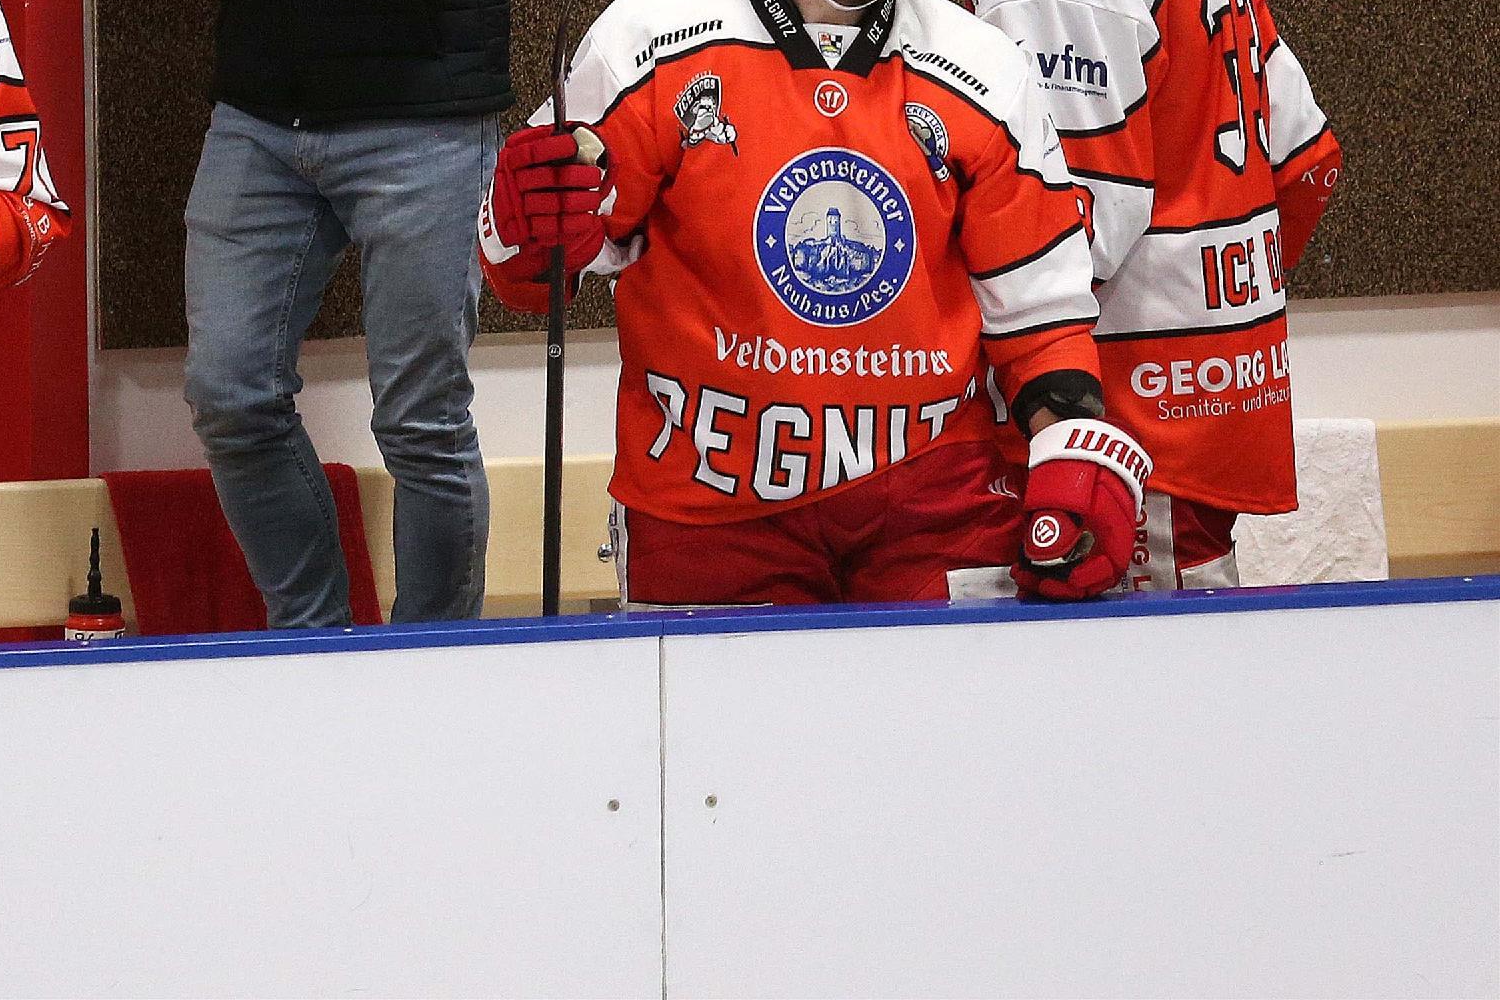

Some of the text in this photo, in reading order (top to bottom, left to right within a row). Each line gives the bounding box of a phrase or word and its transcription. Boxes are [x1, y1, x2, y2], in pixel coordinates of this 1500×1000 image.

[634, 19, 724, 68] WARRIOR
[866, 20, 884, 45] ICE
[903, 44, 990, 97] WARRIOR
[1036, 44, 1108, 88] vfm
[764, 159, 905, 222] Veldensteiner
[771, 264, 898, 319] Neuhaus/Peg.
[1201, 237, 1261, 310] ICE
[1130, 349, 1266, 398] GEORG
[1157, 398, 1236, 420] Sanitär-
[1242, 393, 1262, 412] und
[645, 367, 979, 502] PEGNIT
